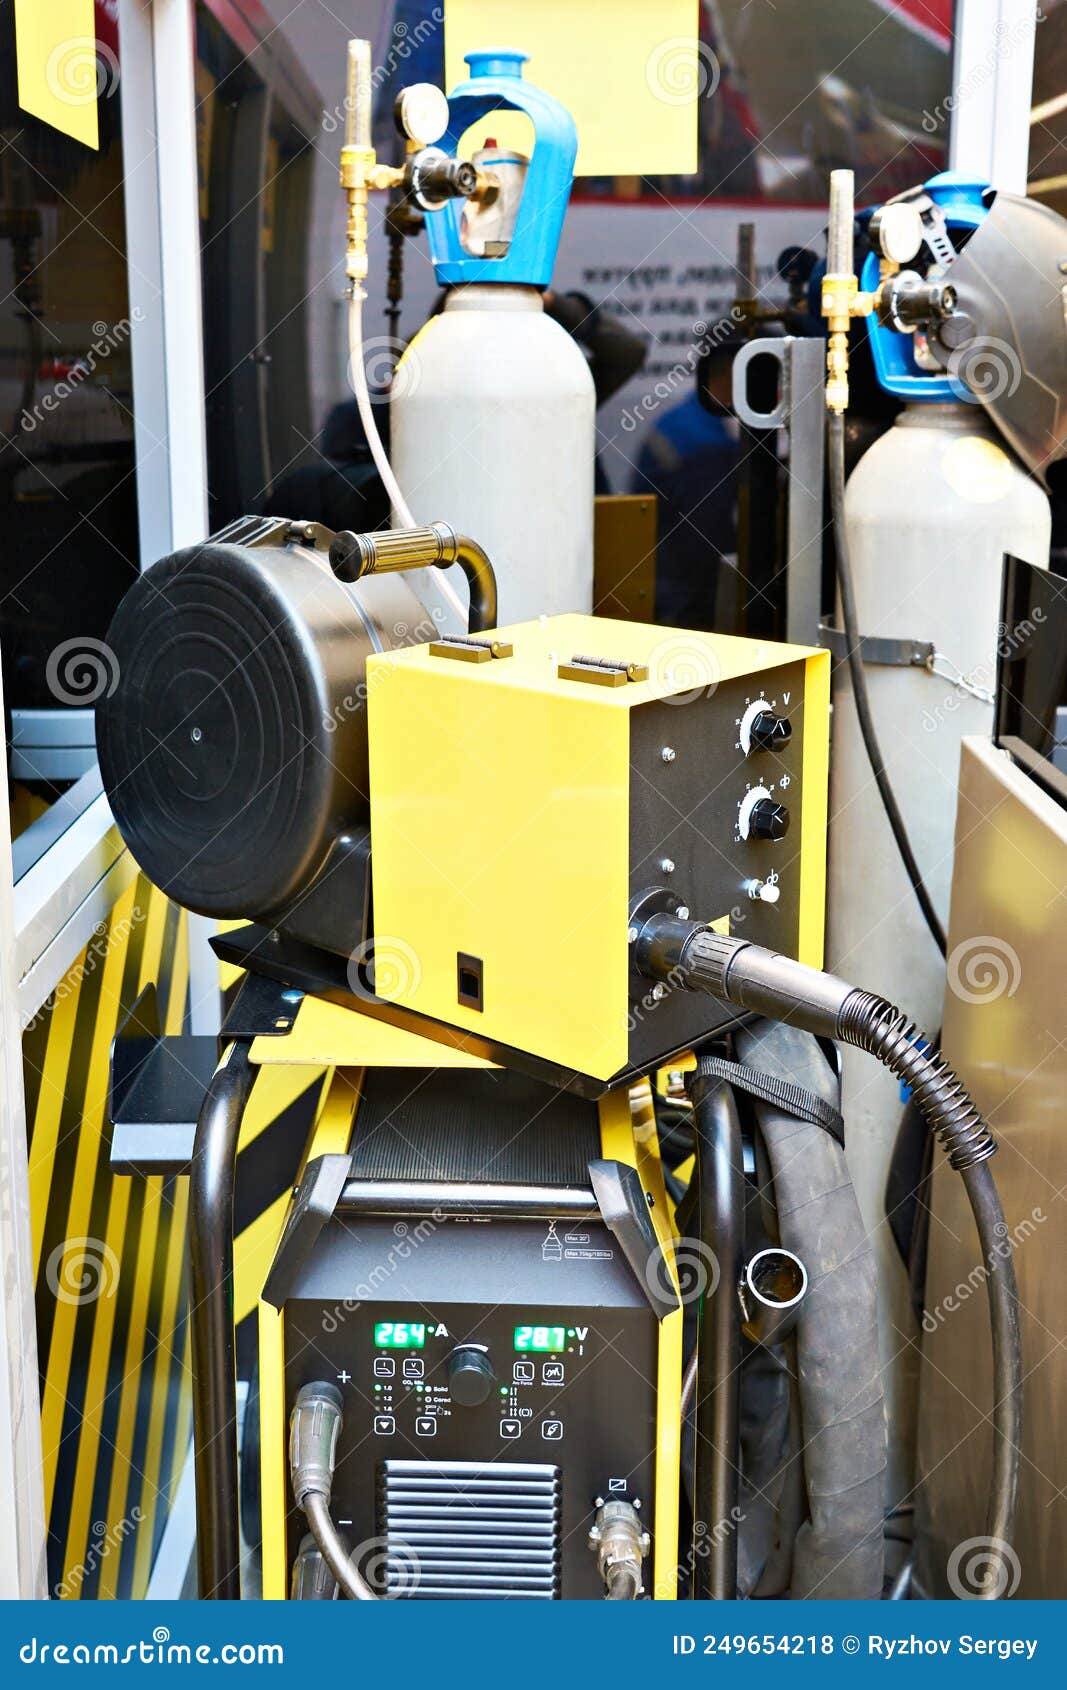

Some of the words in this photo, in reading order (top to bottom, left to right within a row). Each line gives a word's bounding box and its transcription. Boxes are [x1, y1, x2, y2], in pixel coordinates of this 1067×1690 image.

[377, 1323, 425, 1345] 264
[434, 1323, 449, 1337] A
[575, 1327, 588, 1340] V
